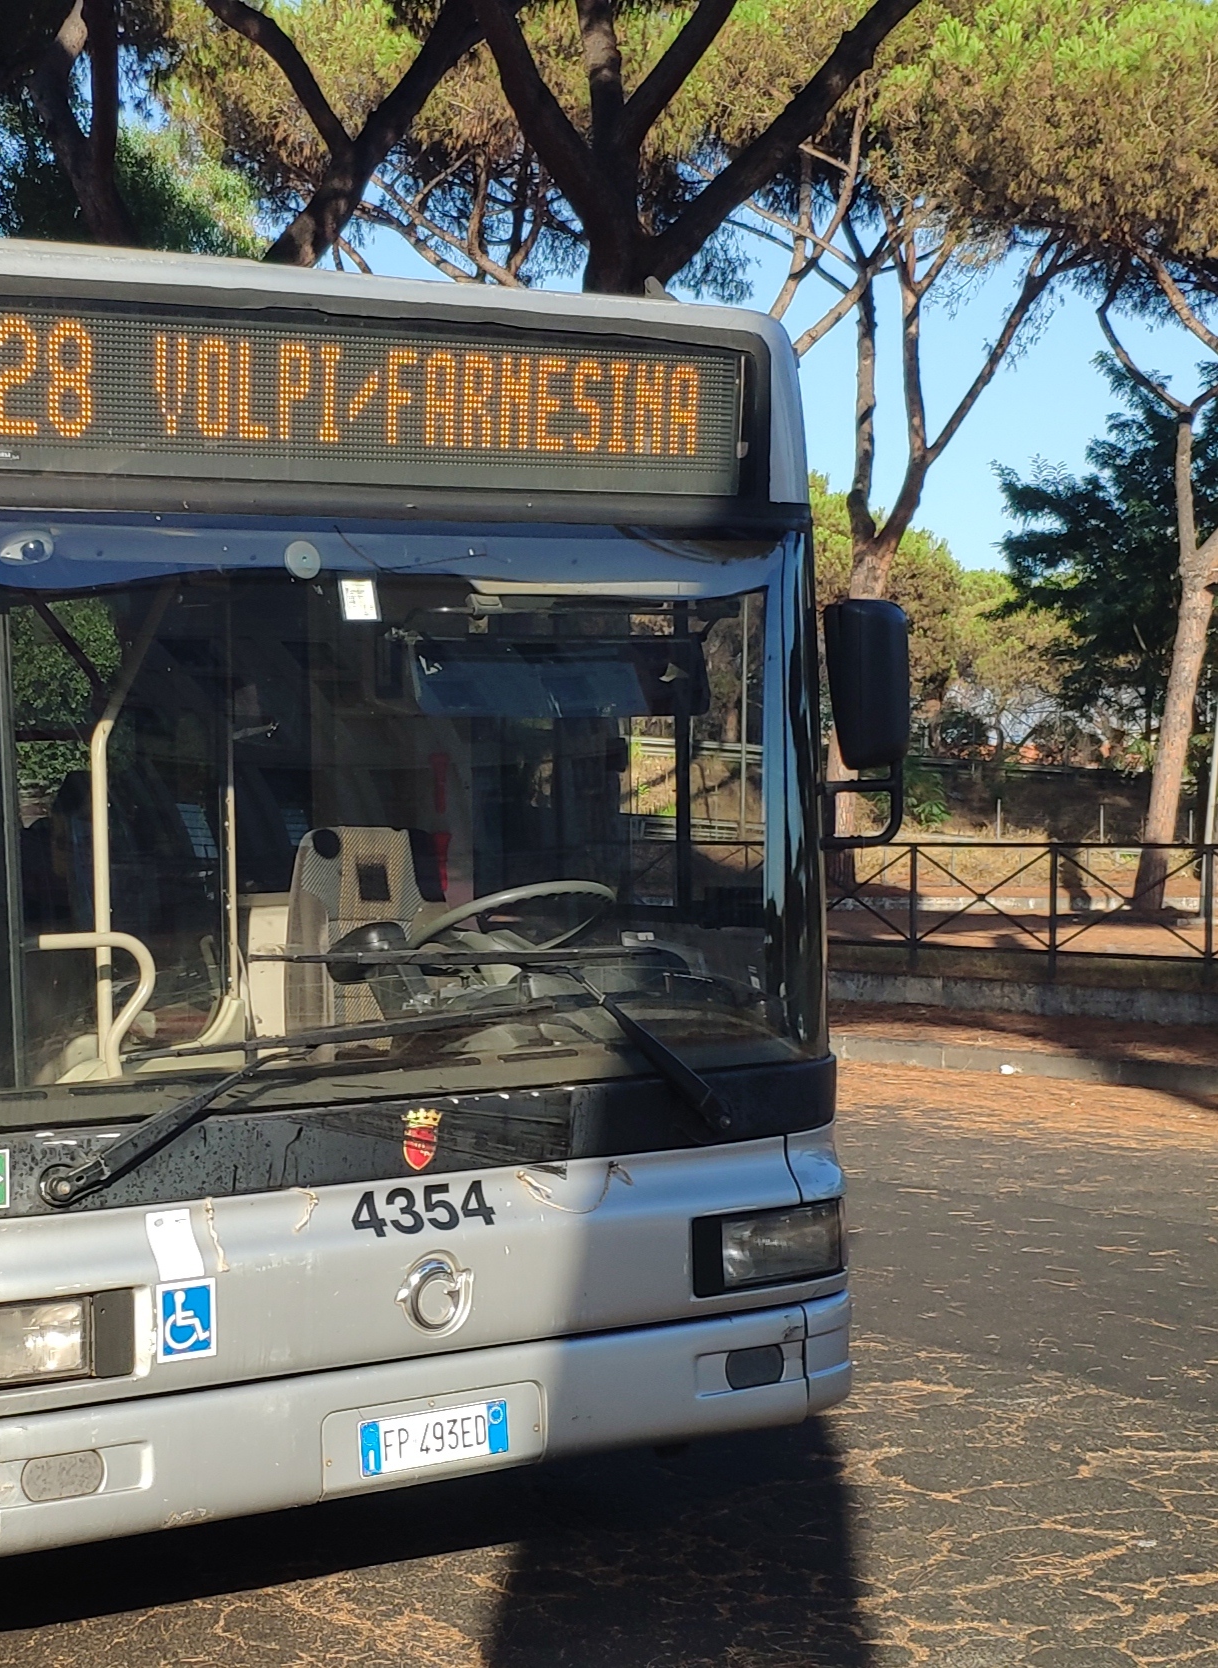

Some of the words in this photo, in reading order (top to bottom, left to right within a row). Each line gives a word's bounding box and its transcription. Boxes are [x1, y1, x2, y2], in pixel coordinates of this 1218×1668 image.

[351, 1179, 496, 1238] 4354
[383, 1427, 410, 1462] FP
[419, 1414, 488, 1455] 493ED
